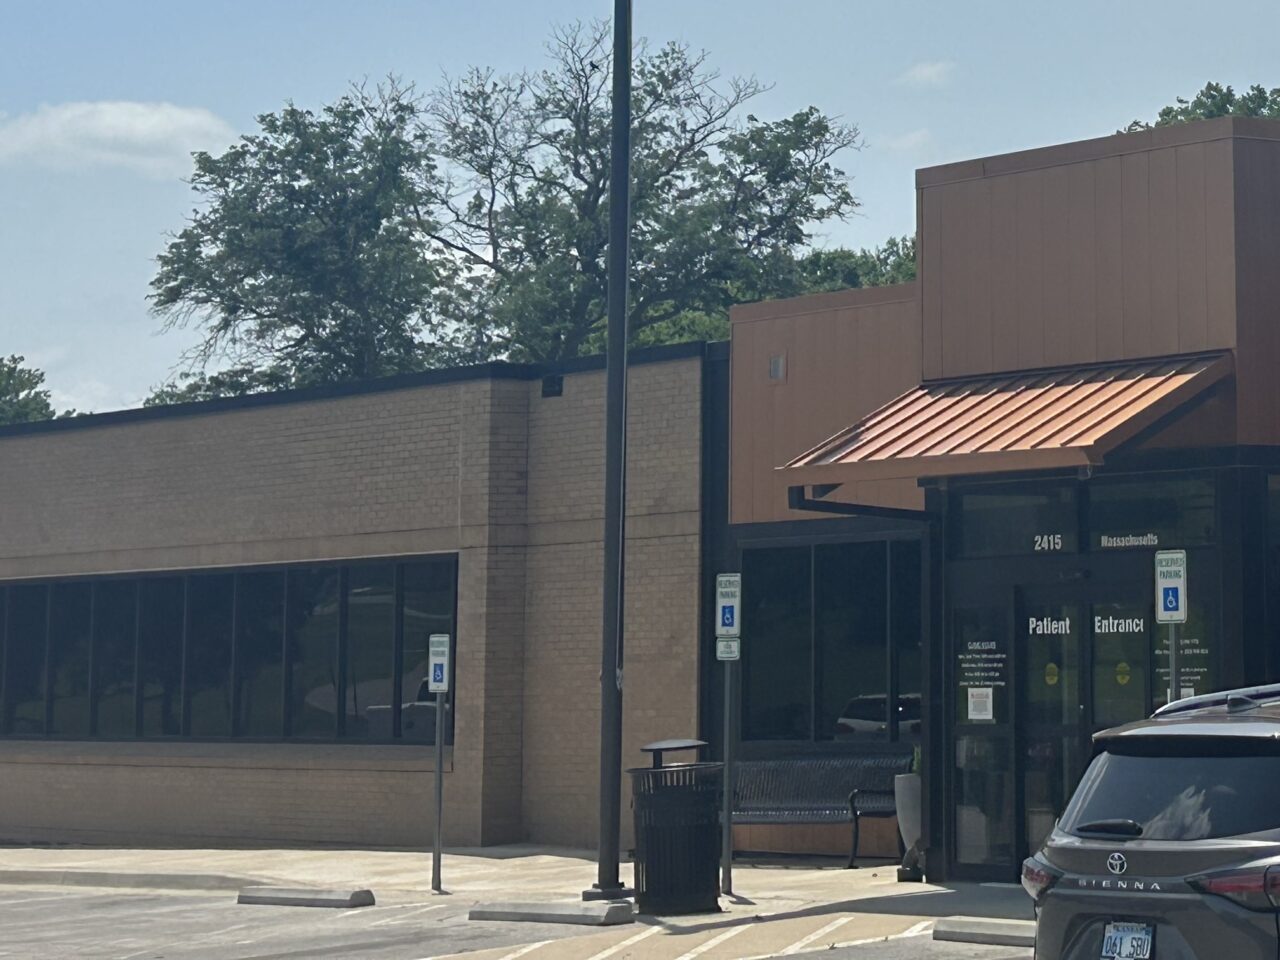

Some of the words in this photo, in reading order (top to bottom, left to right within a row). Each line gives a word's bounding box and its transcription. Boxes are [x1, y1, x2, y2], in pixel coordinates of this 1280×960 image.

[1034, 534, 1062, 551] 2415
[1028, 617, 1071, 635] Patient
[1078, 879, 1161, 890] SIENNA
